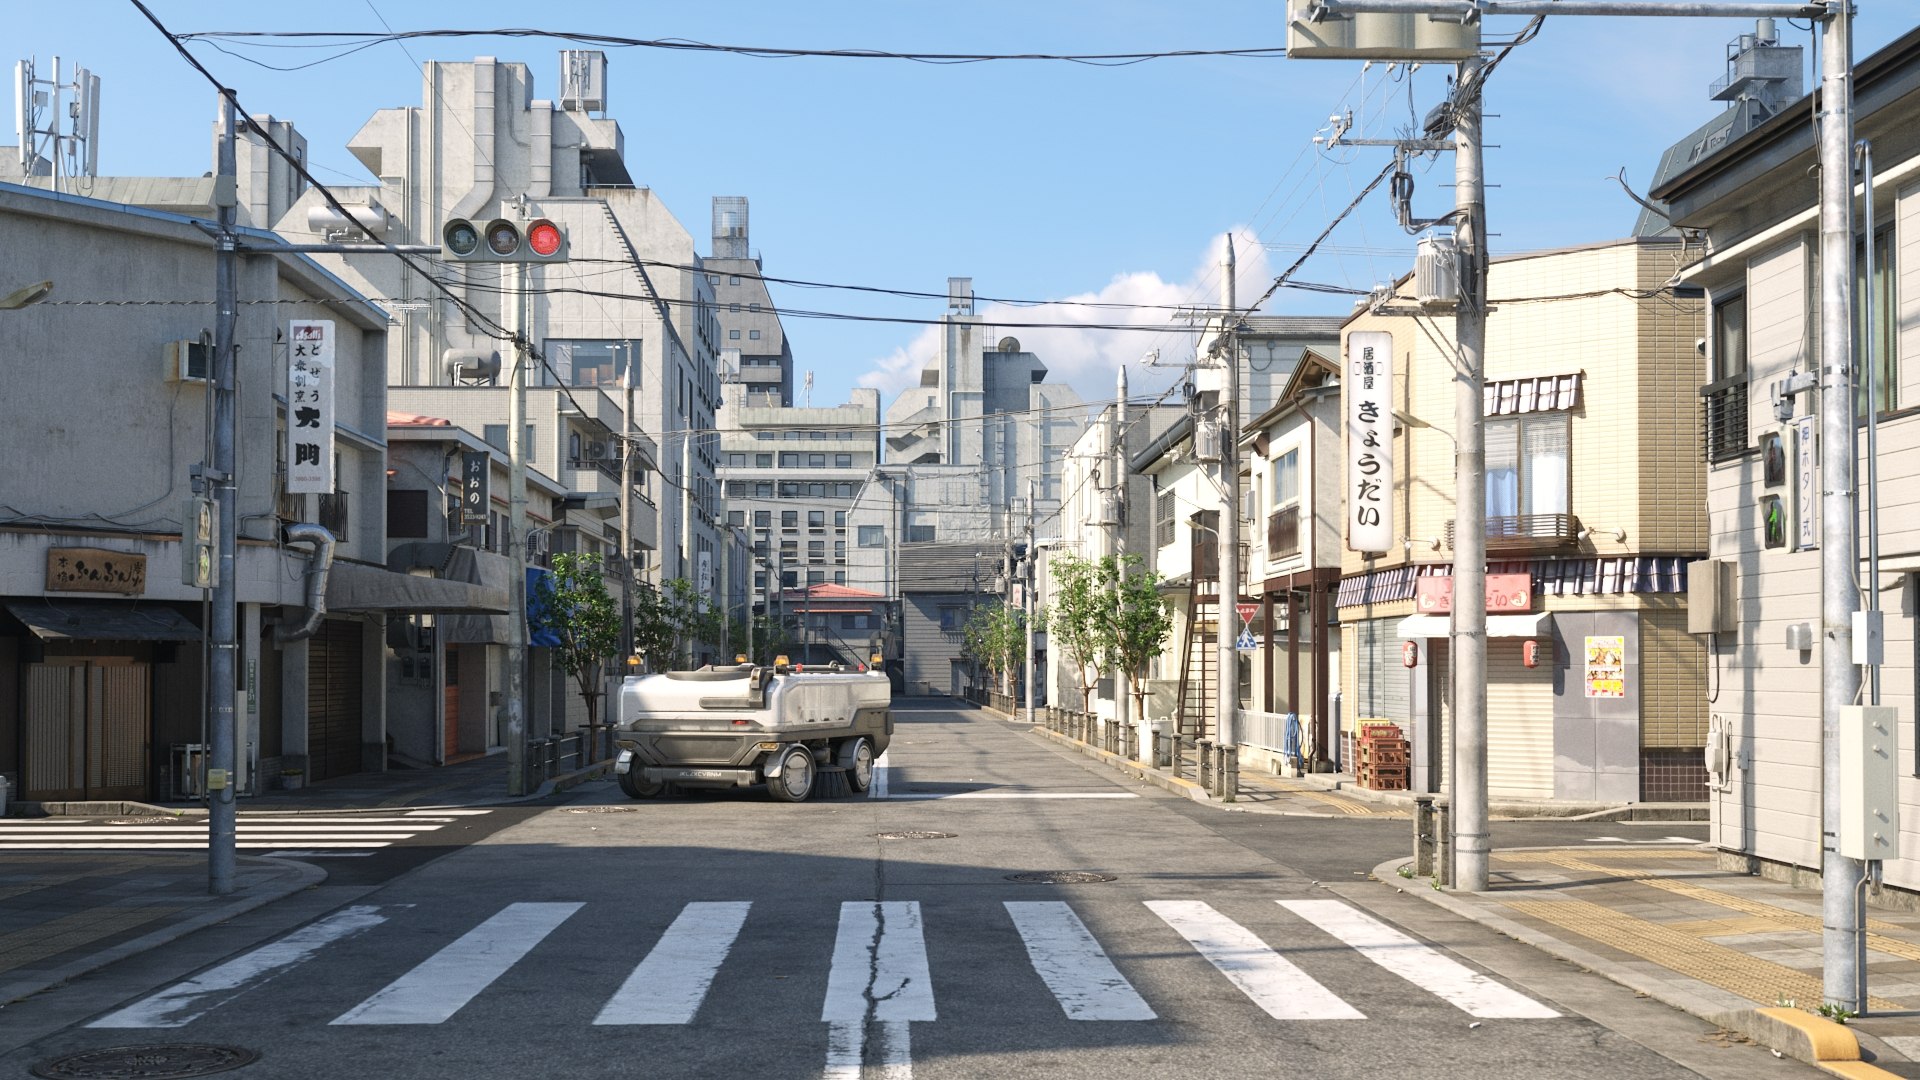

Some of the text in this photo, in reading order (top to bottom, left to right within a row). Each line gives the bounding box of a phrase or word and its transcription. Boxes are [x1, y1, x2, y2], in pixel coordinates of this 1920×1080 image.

[295, 344, 306, 403] 大衆割烹
[310, 344, 320, 402] どぜう
[1363, 346, 1374, 390] 居酒屋
[295, 406, 320, 466] 大門
[1358, 400, 1381, 527] きょうだい
[469, 460, 481, 505] おおの
[1801, 426, 1811, 537] 押ボタン式
